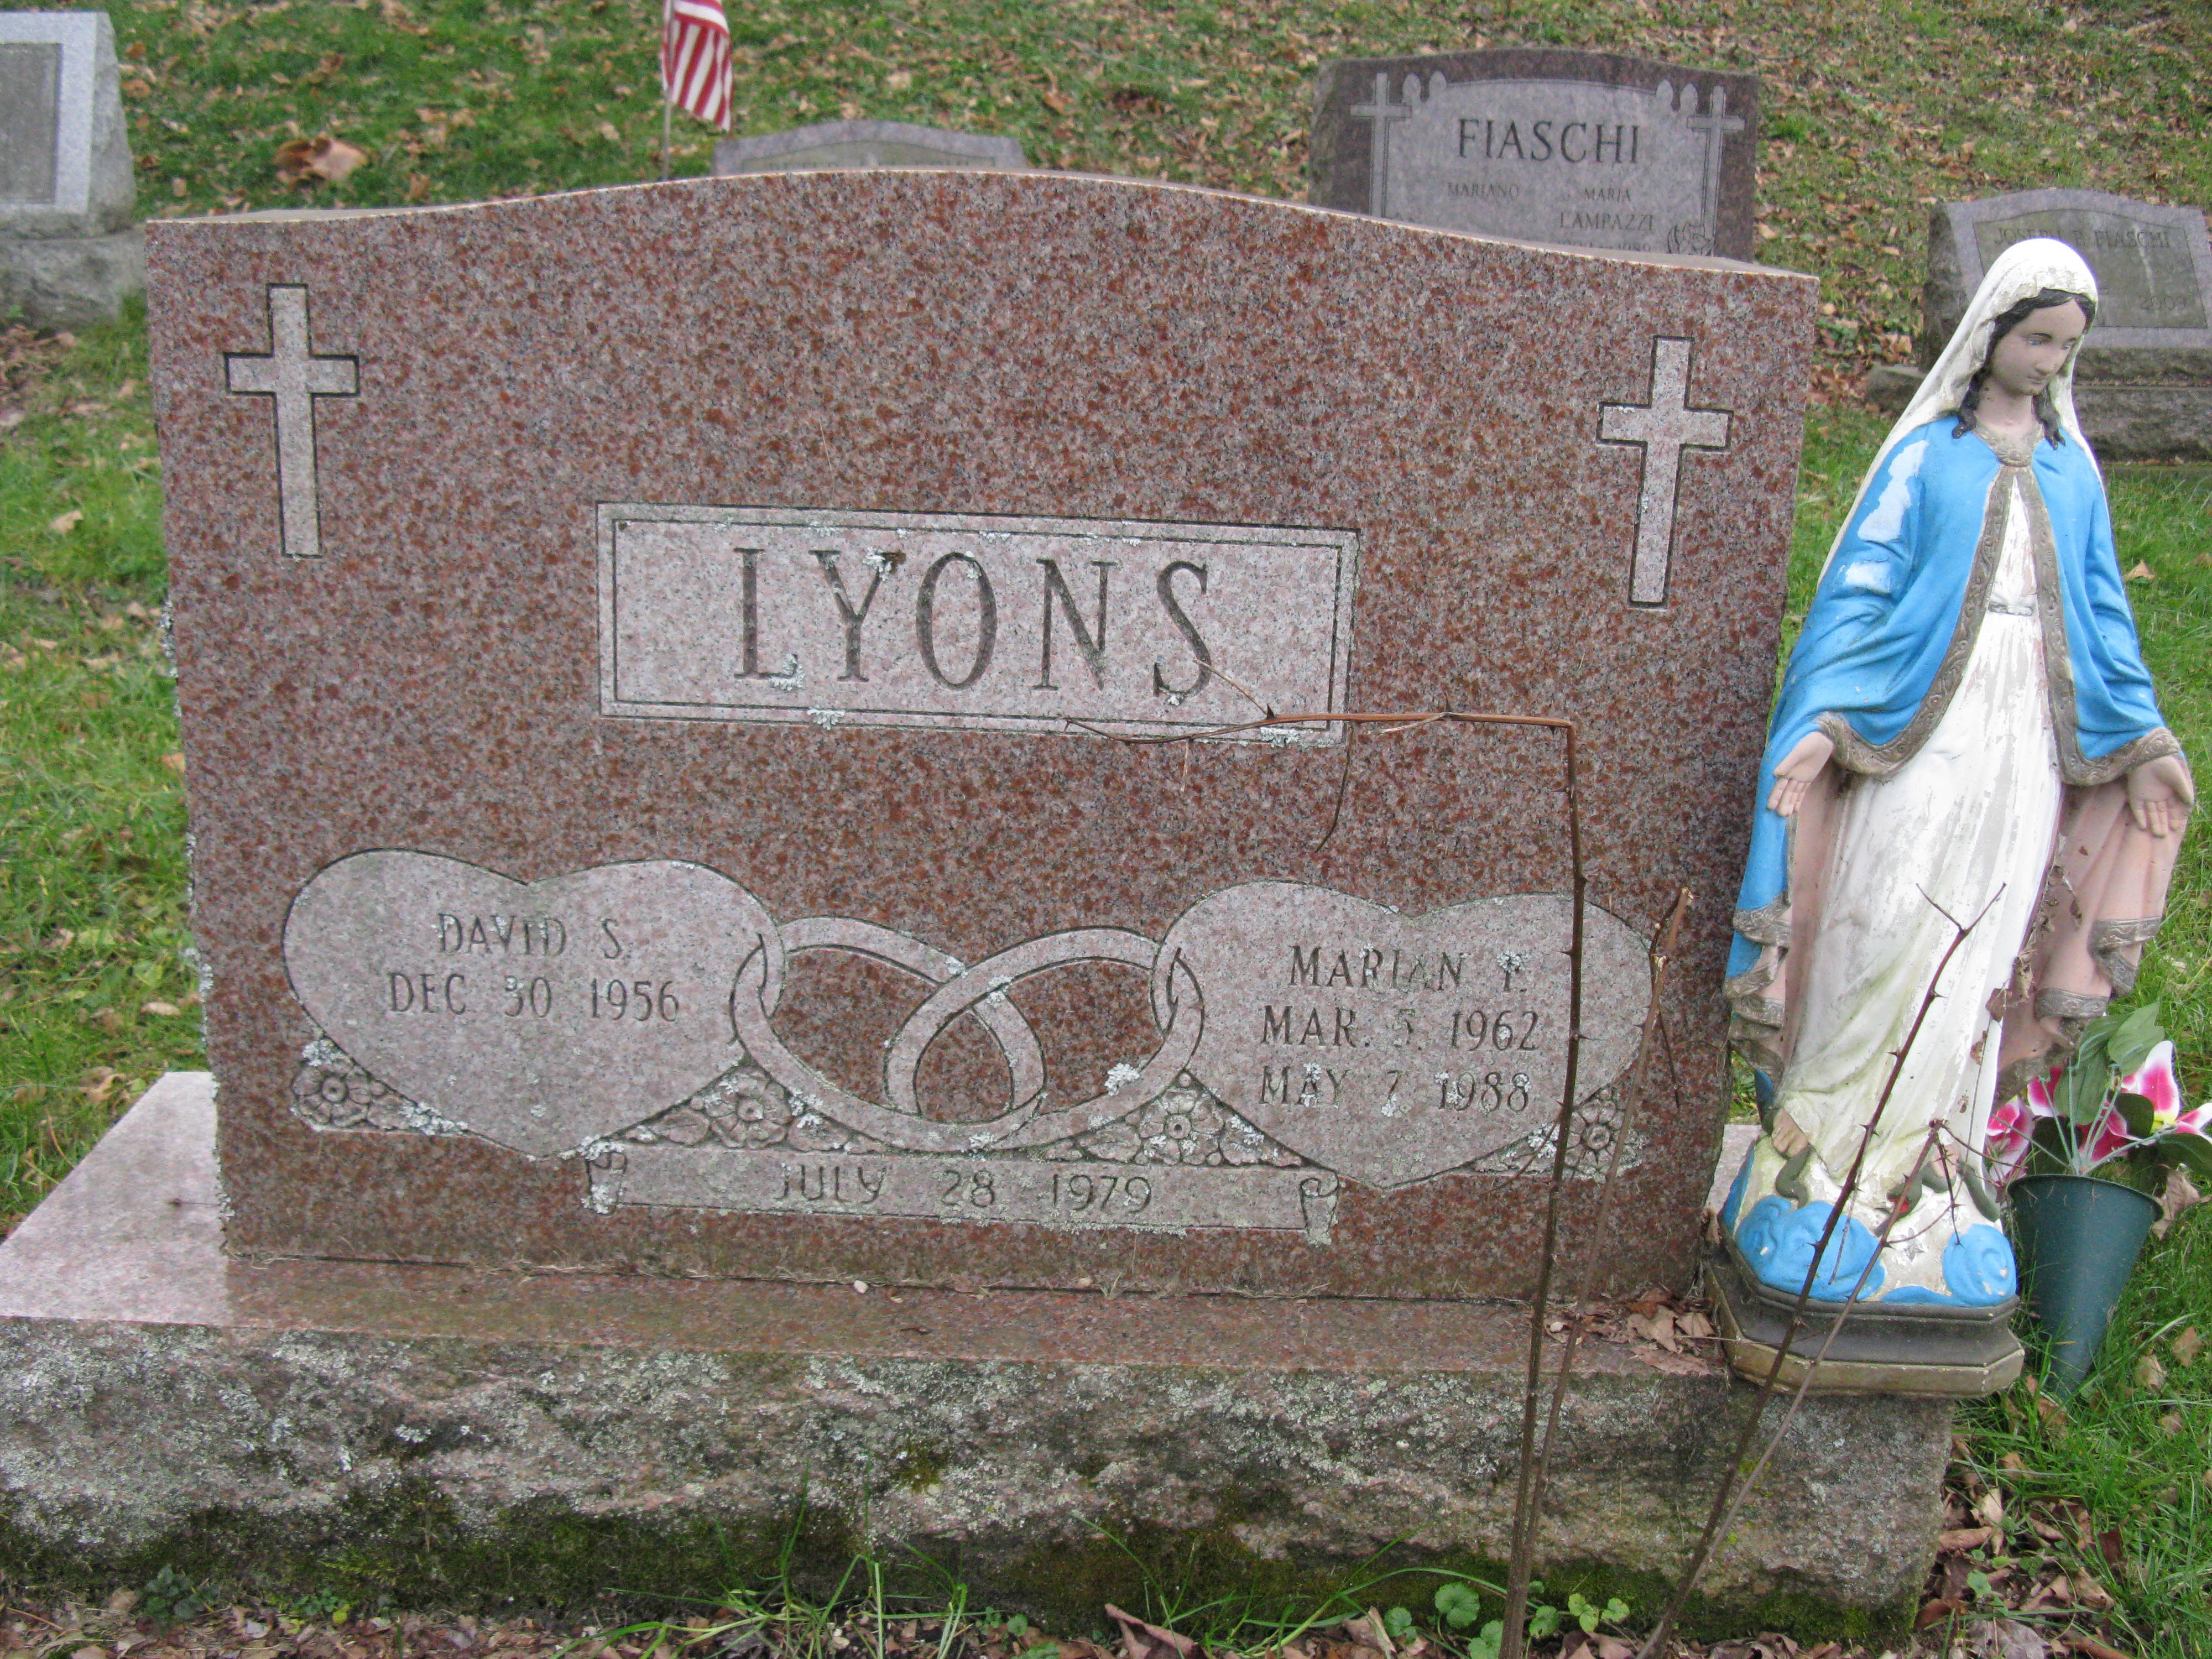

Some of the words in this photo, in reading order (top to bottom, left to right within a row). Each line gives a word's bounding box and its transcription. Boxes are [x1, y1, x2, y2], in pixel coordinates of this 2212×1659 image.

[1458, 118, 1640, 164] FIASCHI
[1448, 181, 1519, 197] MARIANO
[1584, 187, 1631, 202] MARIA
[733, 547, 1212, 700] LYONS
[437, 913, 566, 957] DAVID
[1288, 944, 1470, 992] MARIAN
[387, 972, 466, 1016] DEC
[504, 974, 552, 1018] 30
[591, 977, 680, 1022] 1956
[1261, 1004, 1370, 1048] MAR.
[1451, 1009, 1539, 1051] 1962
[1258, 1066, 1350, 1106] MAY
[1385, 1070, 1403, 1110] 7
[1438, 1071, 1530, 1112] 1988
[774, 1164, 884, 1205] JULY
[942, 1169, 995, 1208] 28
[1051, 1173, 1152, 1214] 1979
